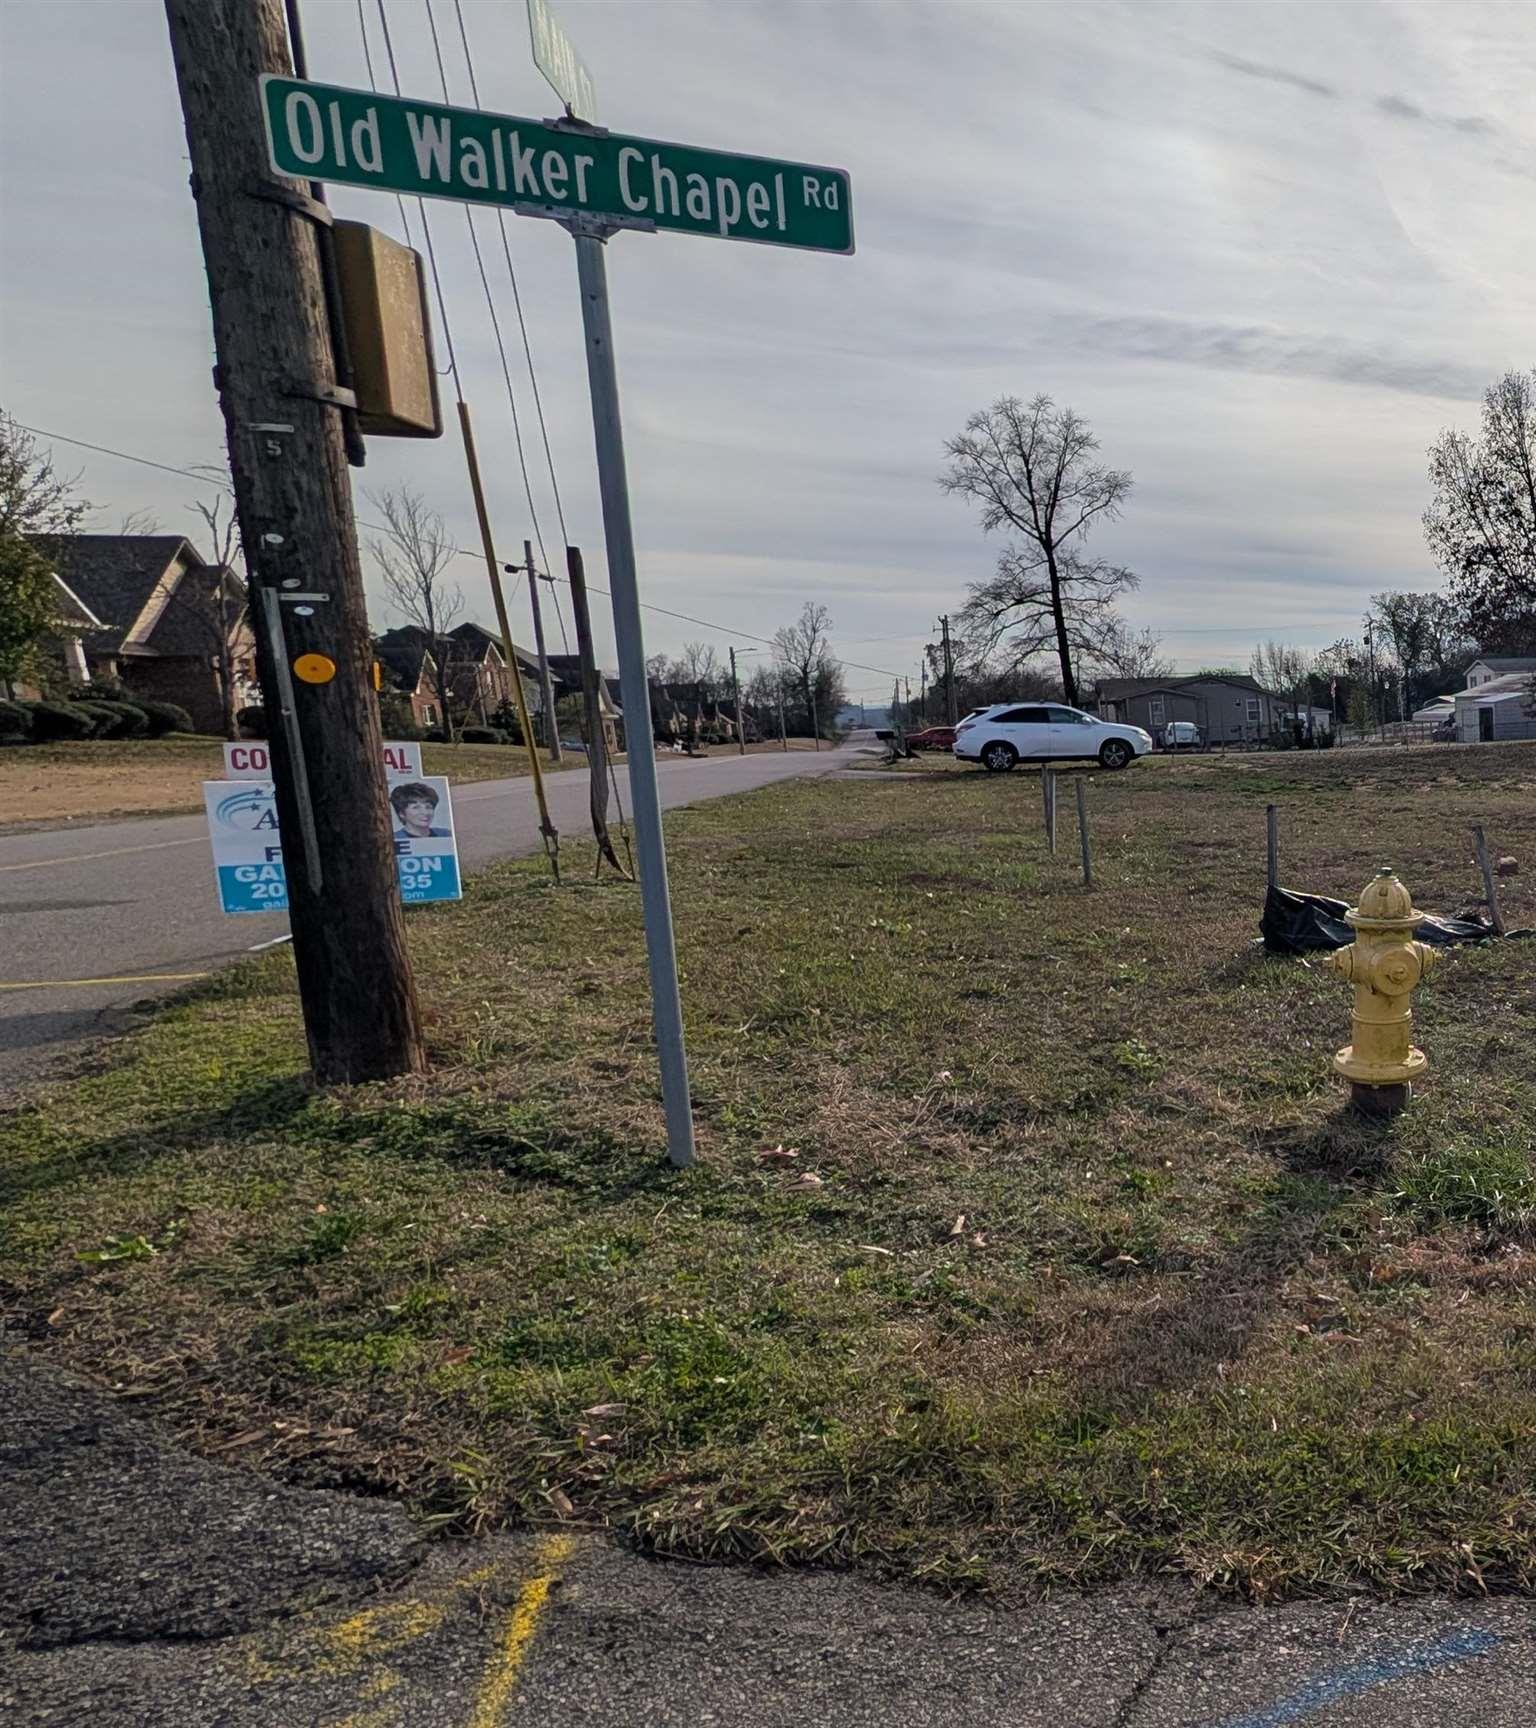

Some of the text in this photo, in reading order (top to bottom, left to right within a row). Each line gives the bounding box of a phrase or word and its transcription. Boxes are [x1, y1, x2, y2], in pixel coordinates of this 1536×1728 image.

[284, 91, 839, 235] Old Walker Chapel Rd
